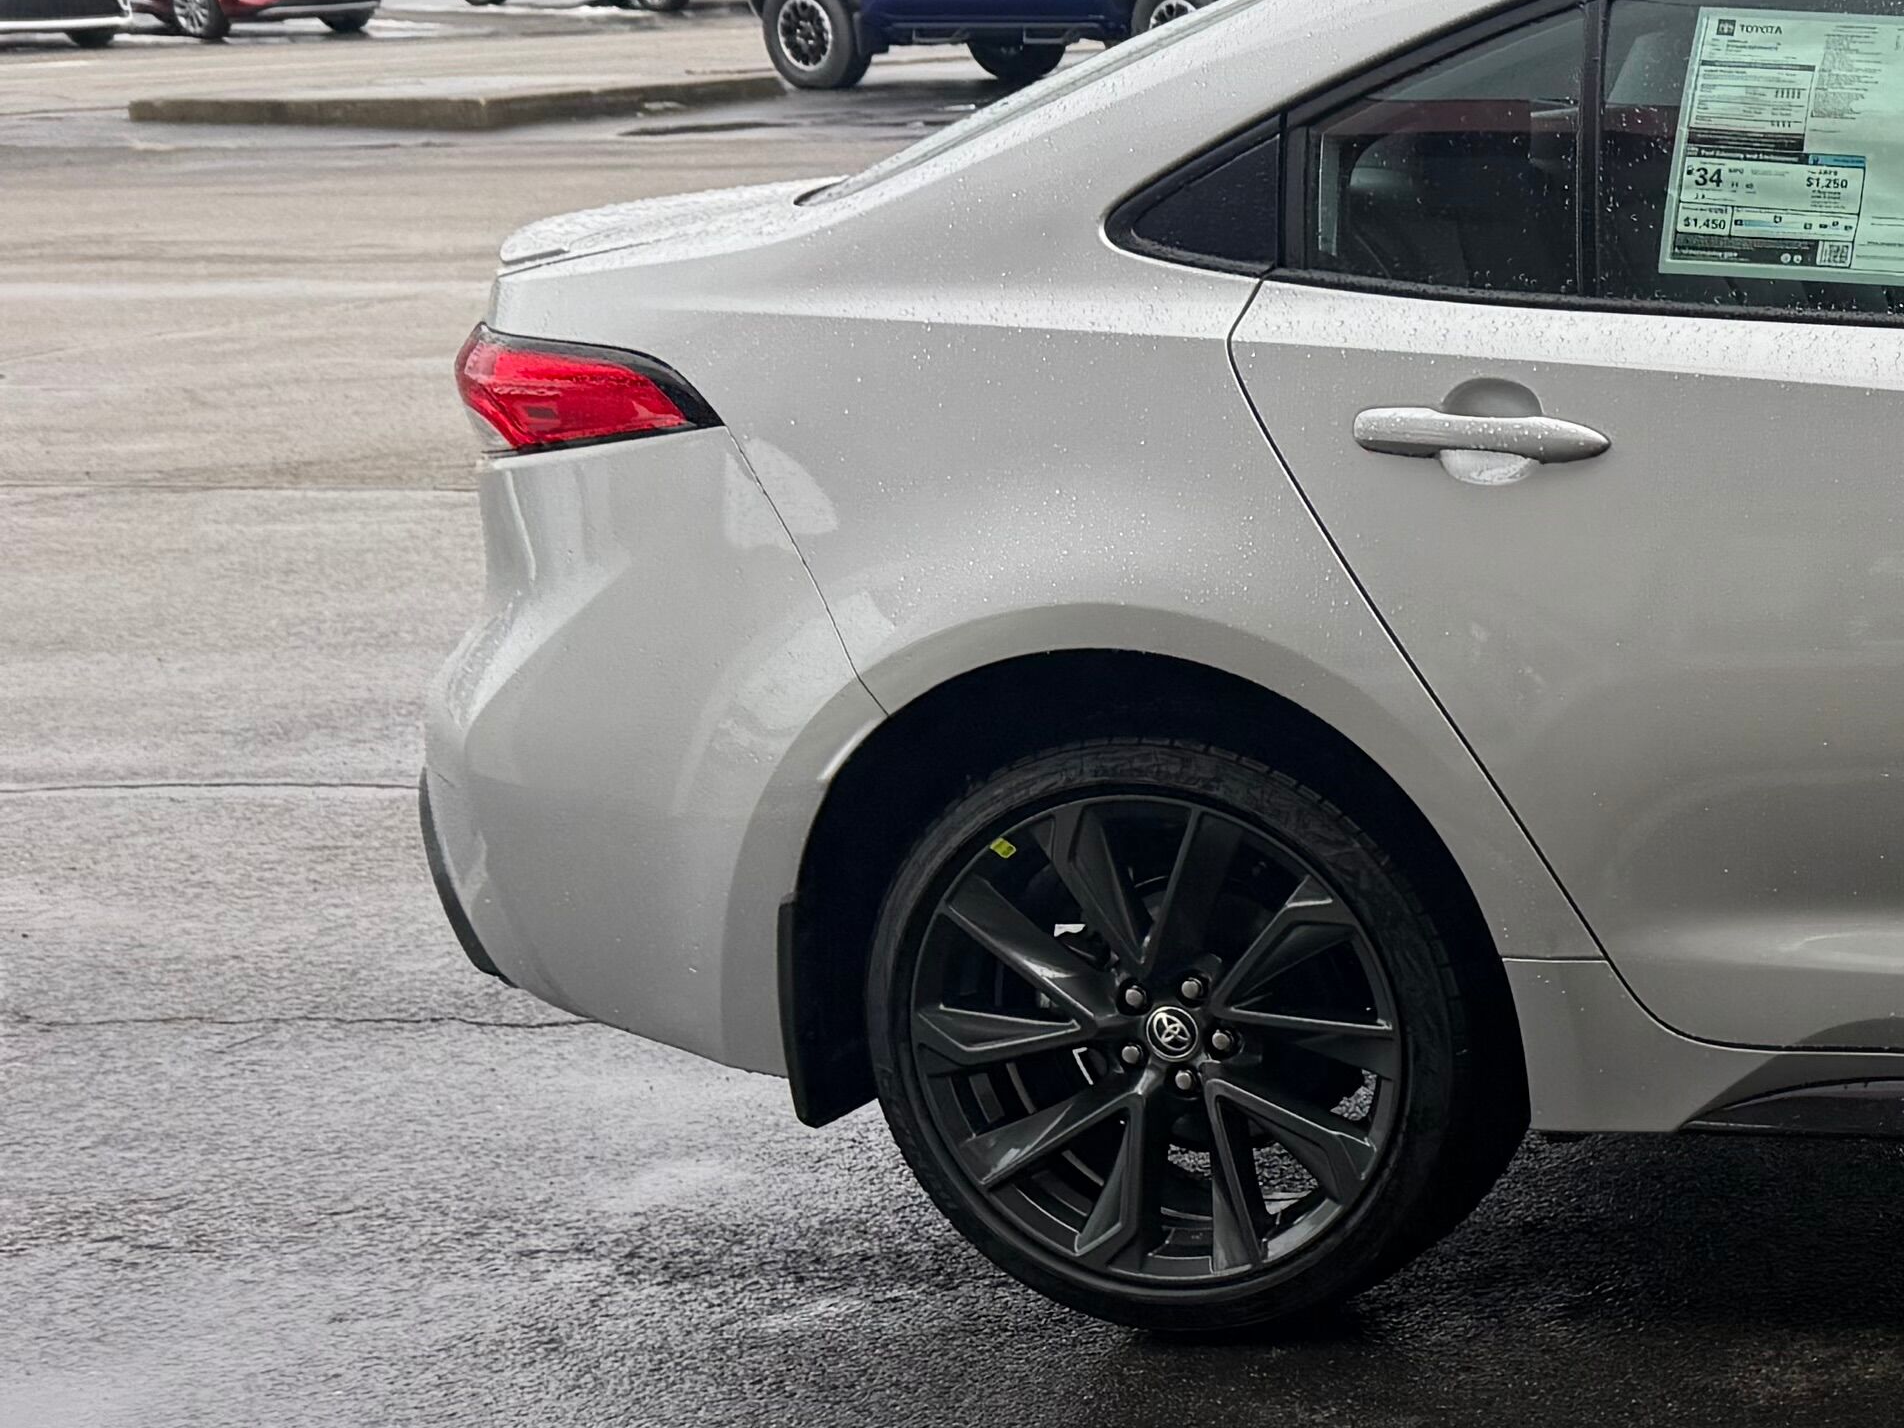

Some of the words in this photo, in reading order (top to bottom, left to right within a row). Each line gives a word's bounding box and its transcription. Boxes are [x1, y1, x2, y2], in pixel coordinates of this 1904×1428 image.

[1739, 23, 1783, 35] TOYOTA
[1694, 167, 1723, 188] 34
[1806, 176, 1849, 189] $1,250
[1683, 215, 1727, 230] $1,450
